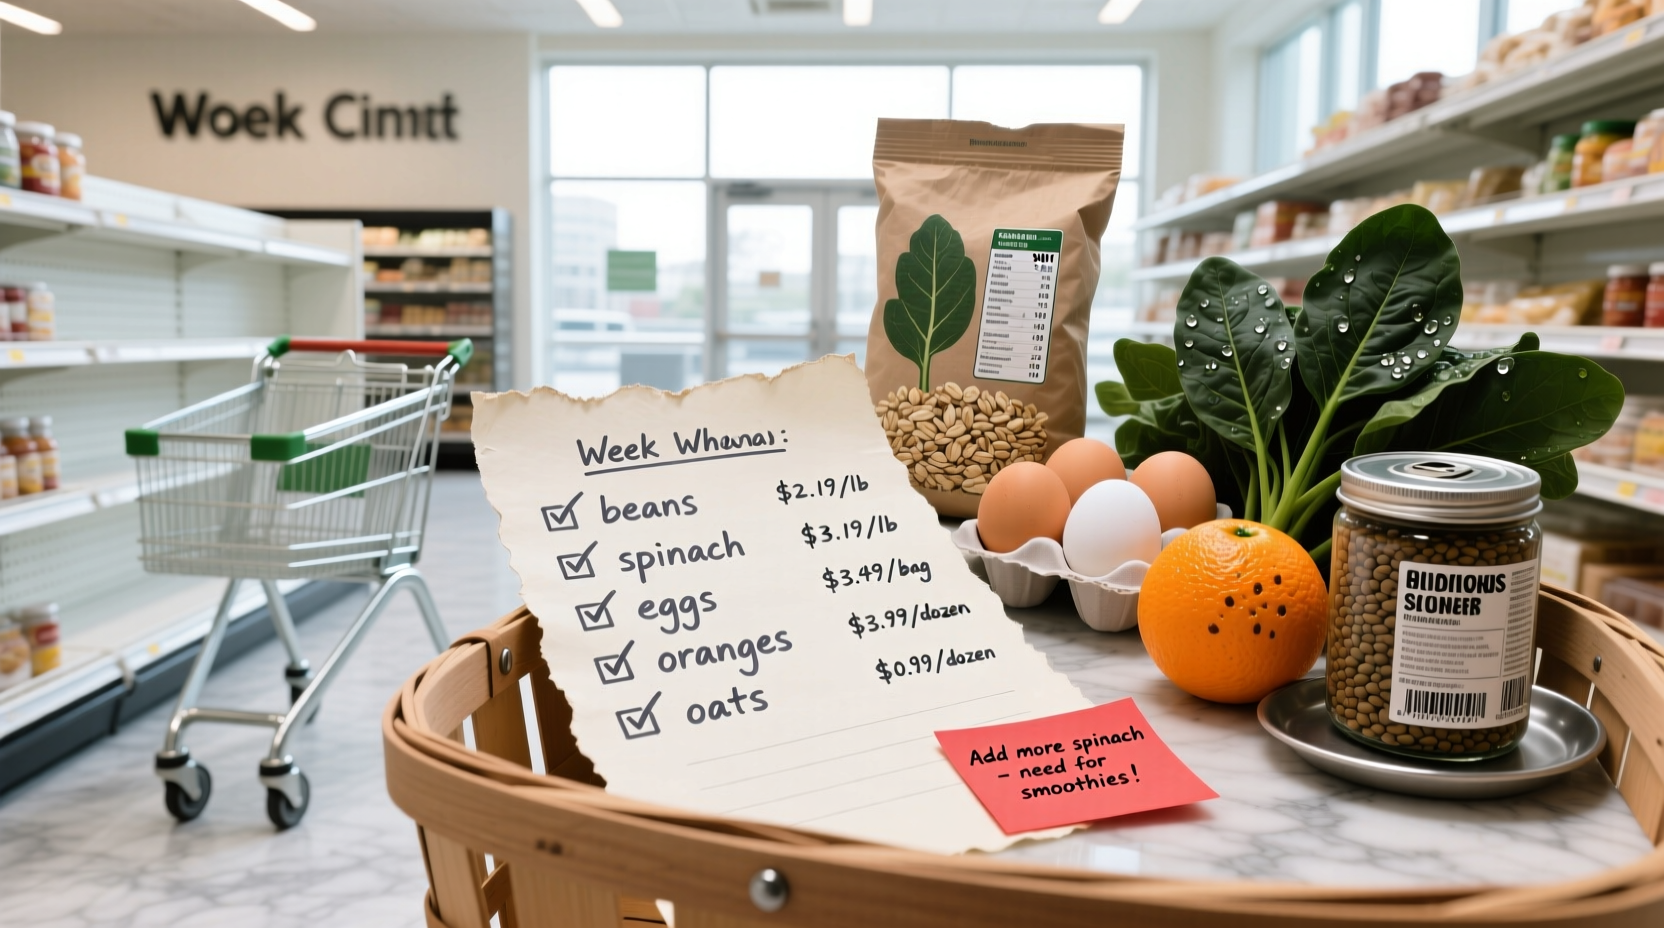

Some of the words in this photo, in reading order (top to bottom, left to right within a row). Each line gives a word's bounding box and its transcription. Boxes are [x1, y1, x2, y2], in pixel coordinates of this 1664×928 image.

[150, 91, 305, 140] Woek
[577, 433, 660, 466] Week
[600, 494, 698, 524] beans
[776, 474, 869, 505] $2.19/lb
[619, 530, 745, 584] spinach
[801, 515, 898, 549] $3.19/lb
[638, 591, 717, 635] eggs
[822, 558, 932, 594] $3.49/bag
[658, 630, 793, 677] oranges
[848, 603, 971, 639] $3.99/dozen
[687, 686, 769, 725] oats
[875, 648, 996, 684] $0.99/dozen
[970, 744, 1008, 766] Add
[1016, 742, 1065, 759] more
[1072, 725, 1145, 754] spinach
[1020, 758, 1067, 778] need
[1075, 755, 1107, 771] for
[1021, 764, 1140, 800] smoothies!
